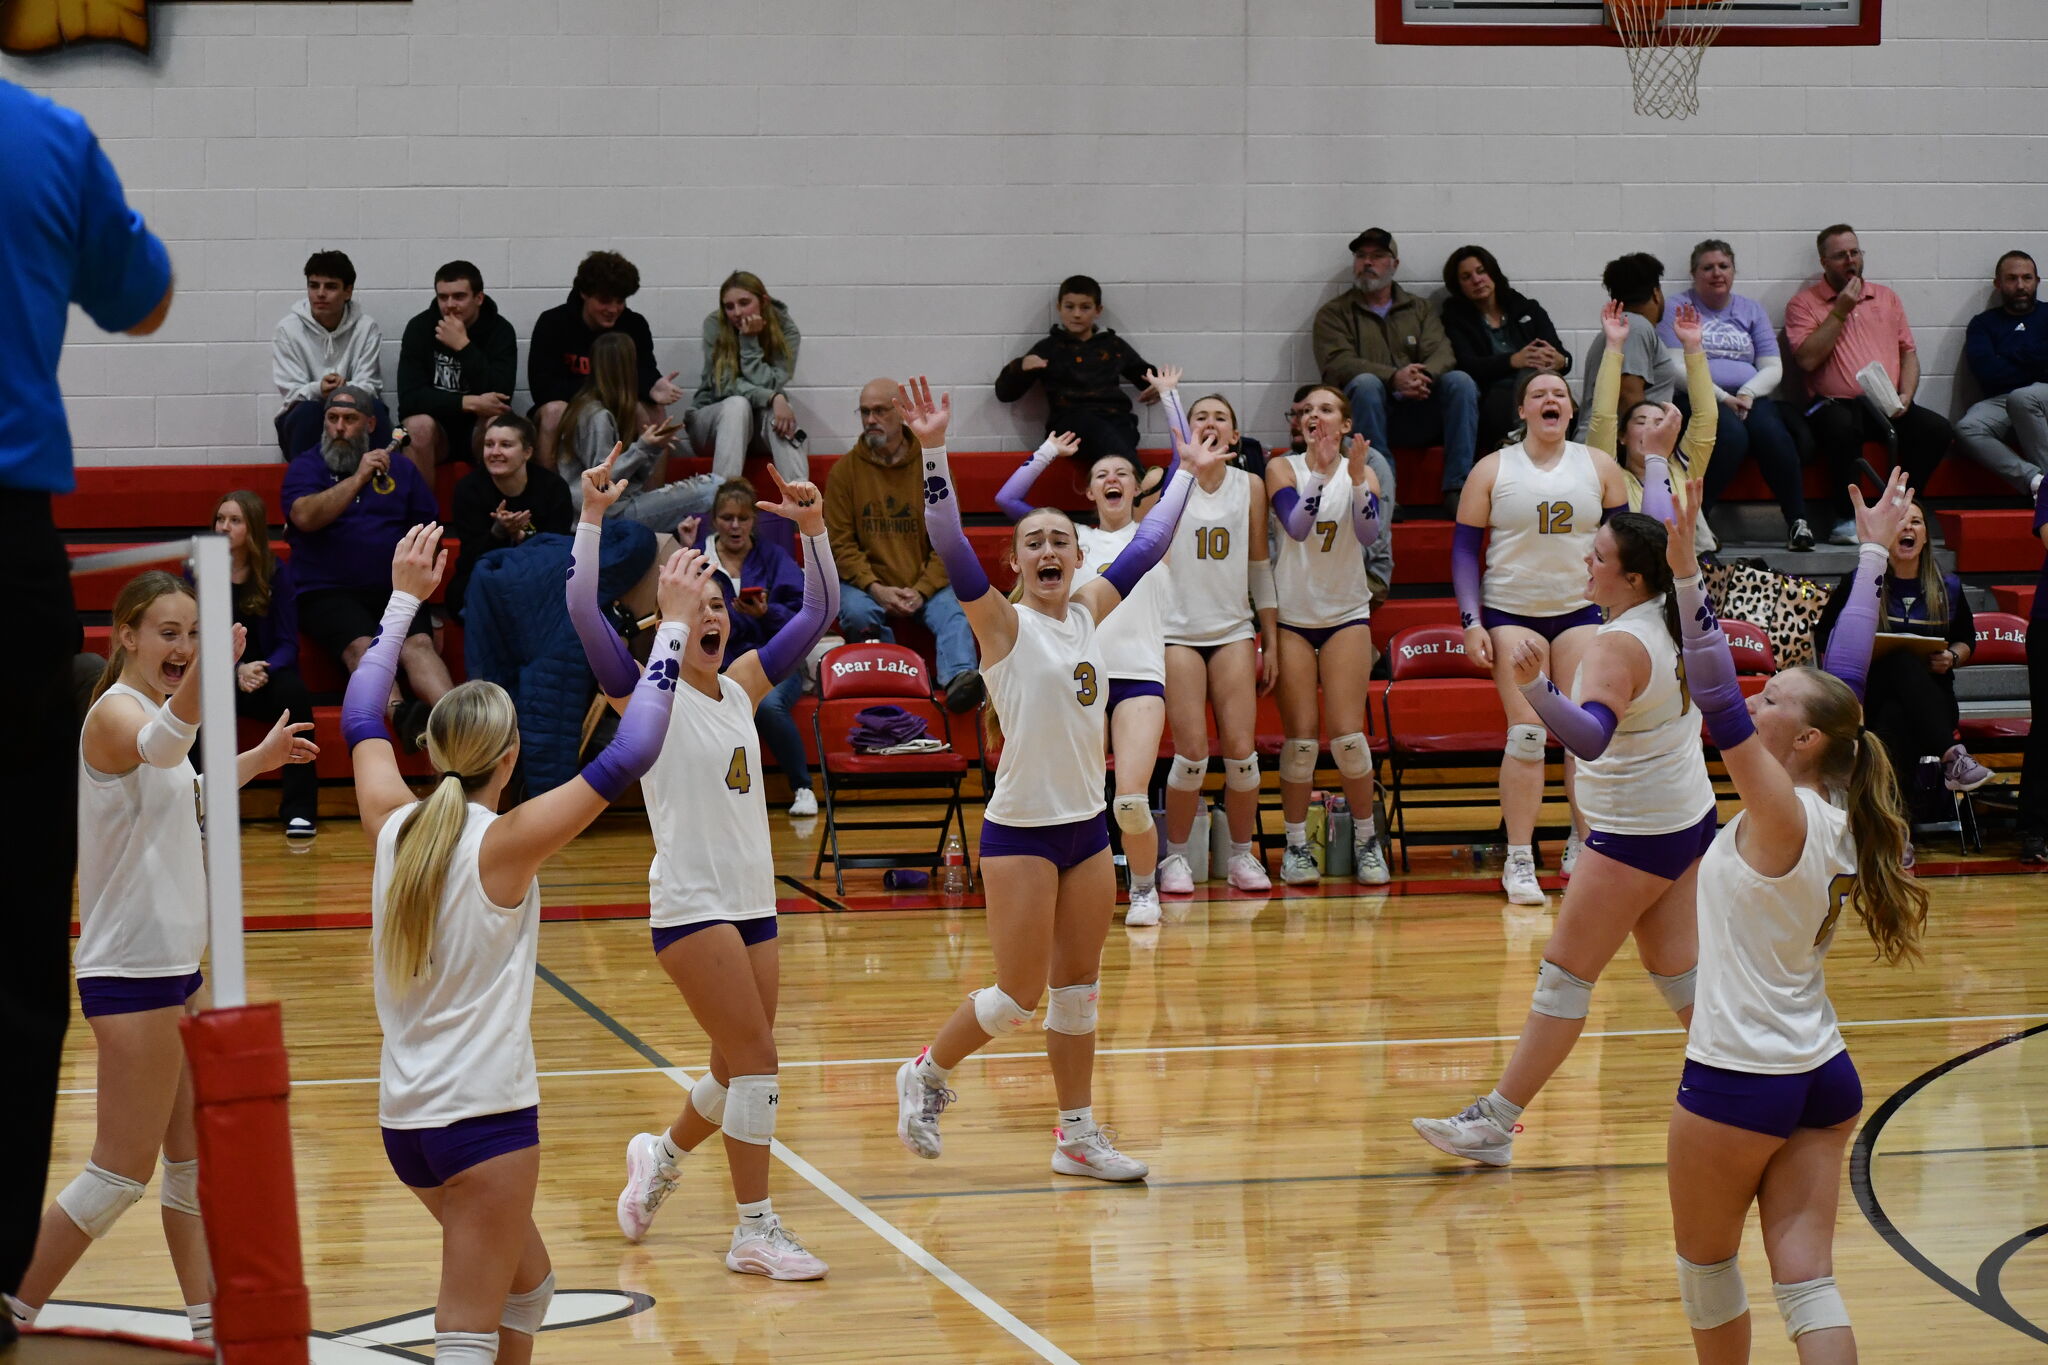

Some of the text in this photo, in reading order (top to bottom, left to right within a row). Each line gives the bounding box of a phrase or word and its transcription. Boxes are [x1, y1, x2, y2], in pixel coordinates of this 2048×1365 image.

[1537, 501, 1573, 534] 12
[1195, 526, 1230, 560] 10
[1316, 521, 1338, 553] 7
[1400, 640, 1467, 660] Bear La
[1725, 633, 1764, 652] Lake
[1975, 627, 2026, 644] ar Lak
[831, 658, 918, 678] Bear Lake
[1074, 661, 1098, 706] 3
[724, 746, 751, 794] 4
